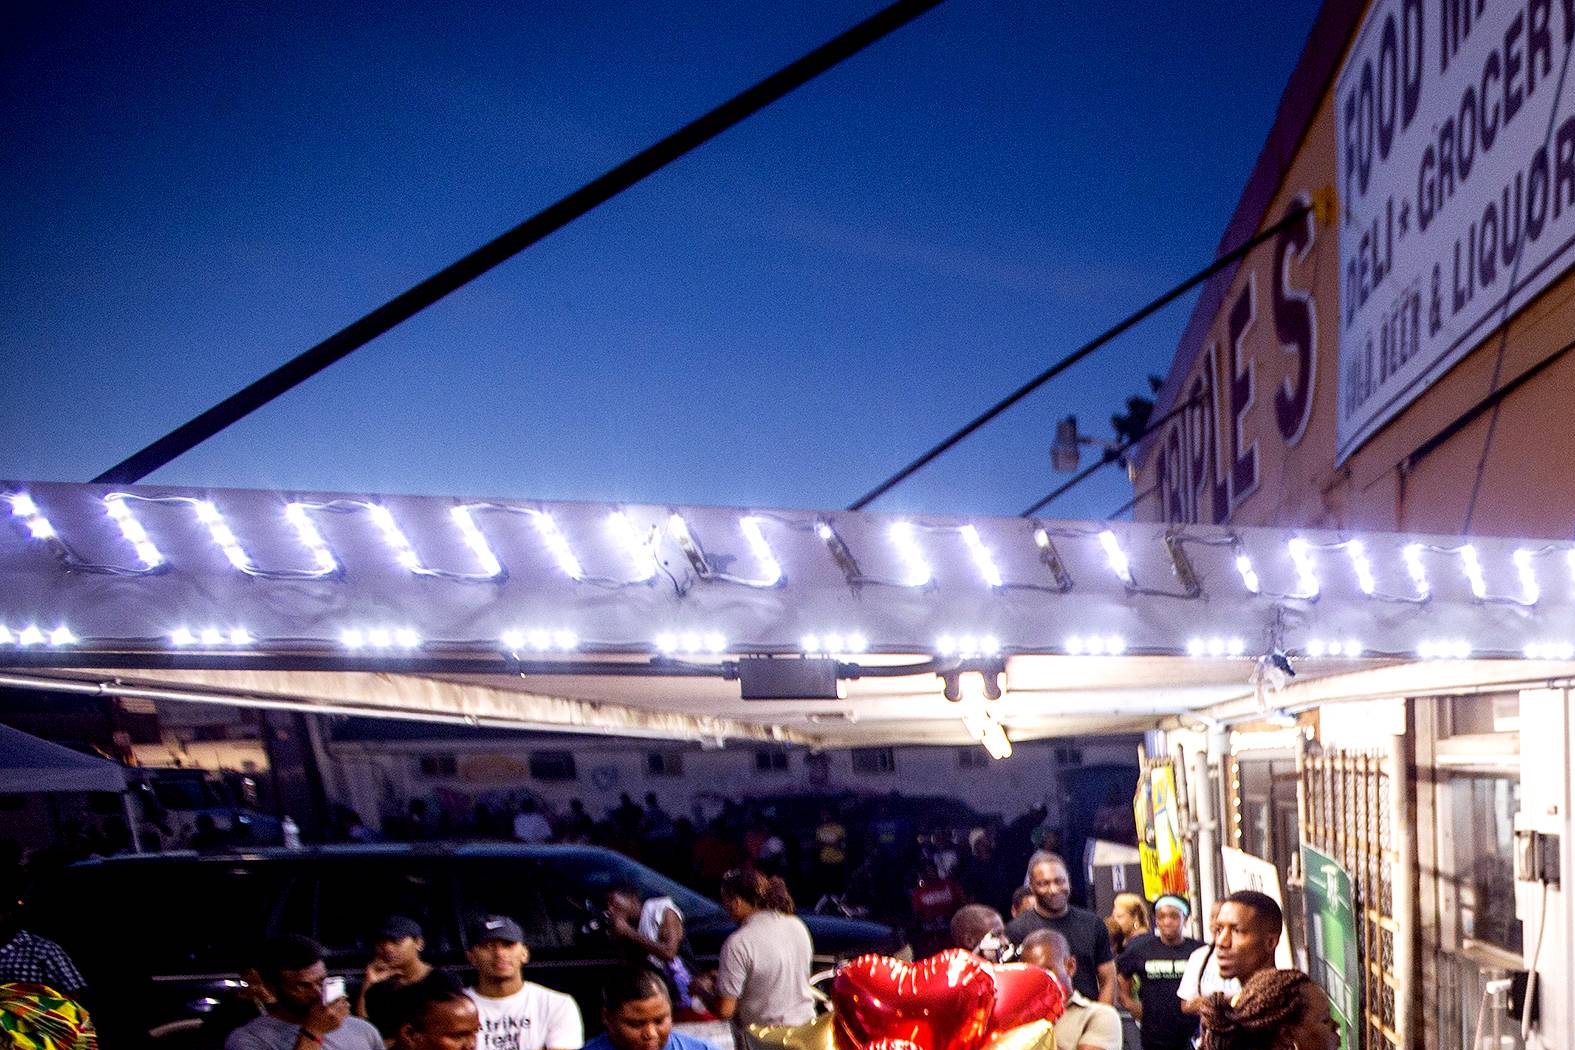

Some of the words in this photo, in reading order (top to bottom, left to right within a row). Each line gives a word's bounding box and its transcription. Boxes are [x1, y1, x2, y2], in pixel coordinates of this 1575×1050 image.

[1344, 0, 1422, 229] FOOD
[1345, 196, 1394, 330] DELI
[479, 1016, 531, 1031] trike
